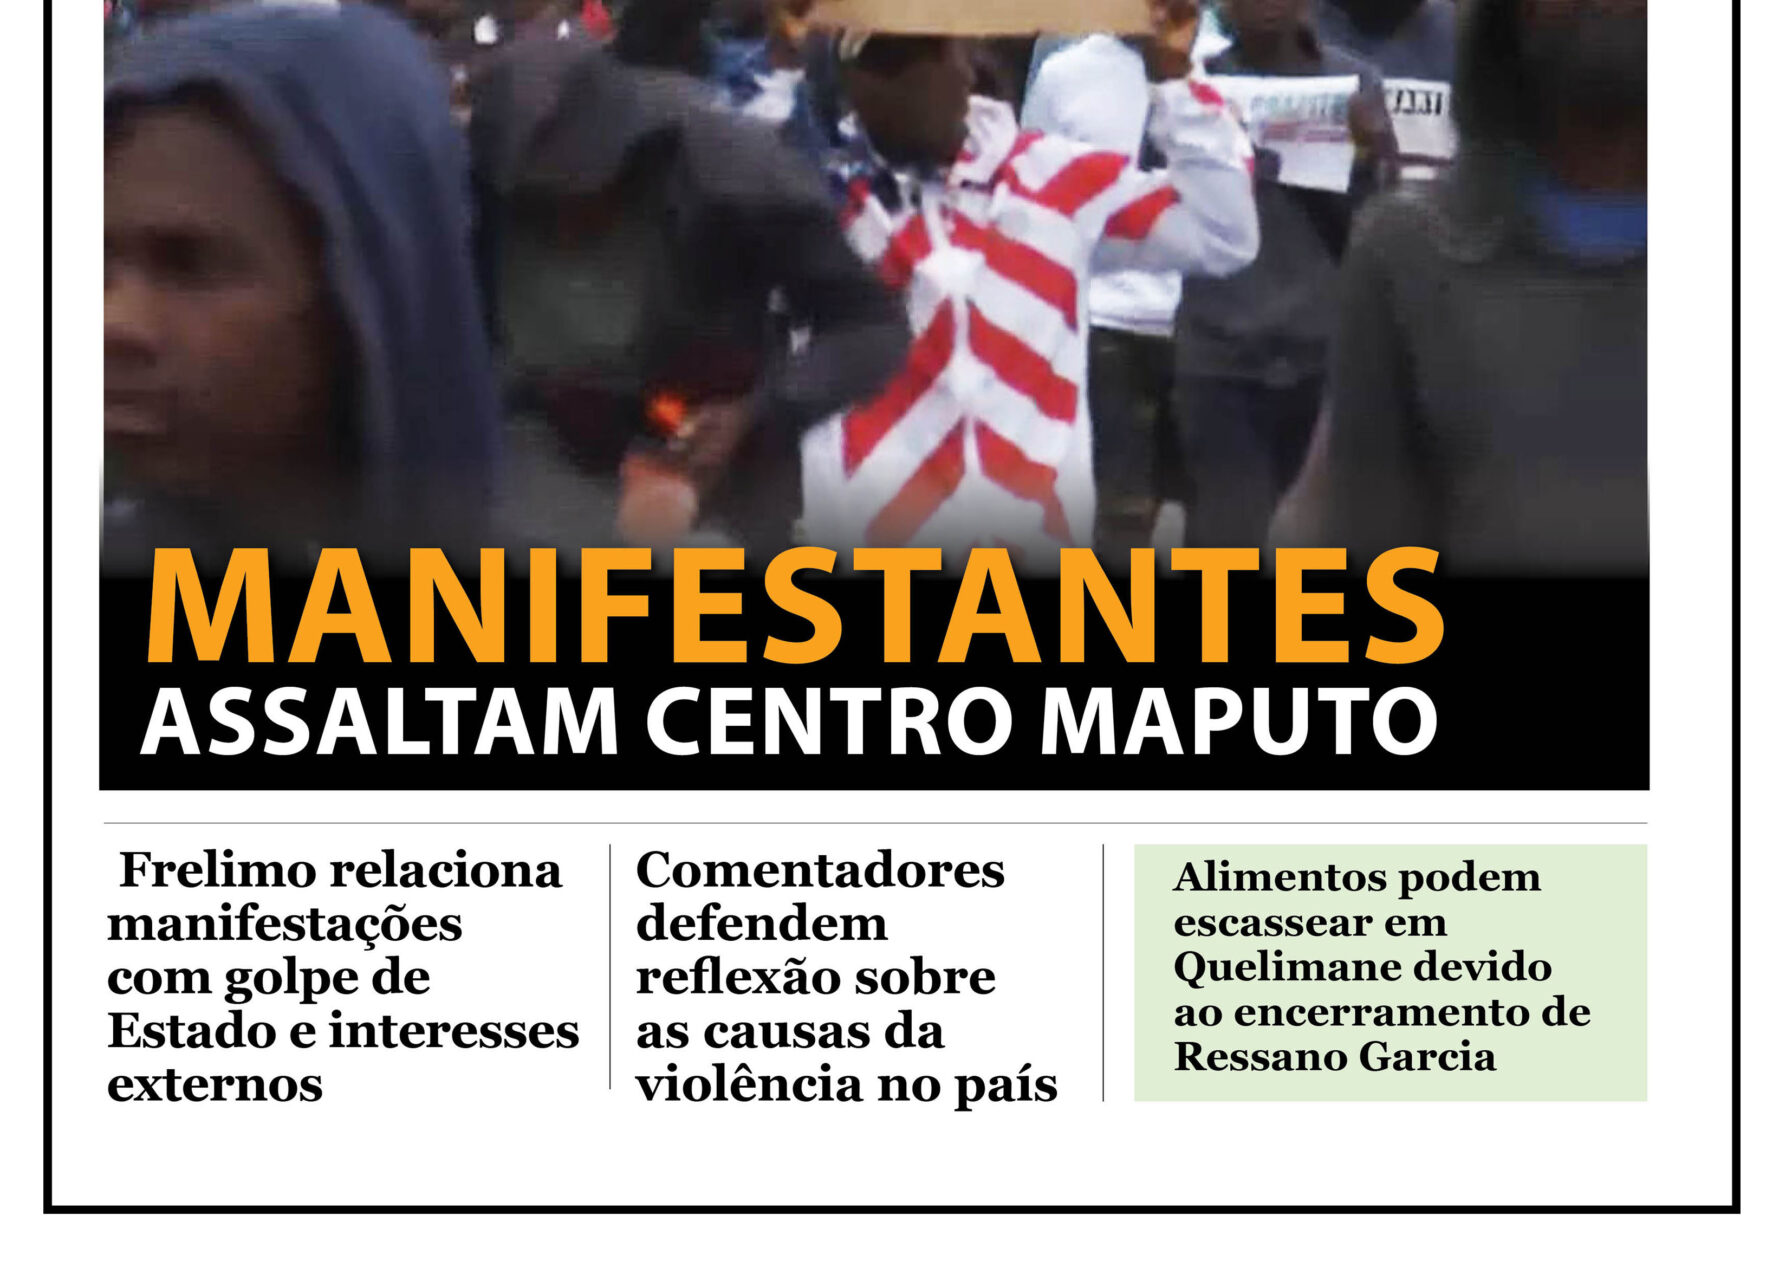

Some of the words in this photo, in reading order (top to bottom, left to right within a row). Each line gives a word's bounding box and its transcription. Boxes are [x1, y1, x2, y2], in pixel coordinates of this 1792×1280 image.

[148, 546, 1444, 664] MANIFESTANTES
[140, 687, 617, 755] ASSALTAM
[647, 687, 1012, 755] CENTRO
[1042, 687, 1437, 755] MAPUTO
[120, 849, 316, 888] Frelimo
[330, 849, 563, 888] relaciona
[637, 849, 1004, 888] Comentadores
[1172, 860, 1387, 891] Alimentos
[1398, 859, 1542, 900] podem
[107, 902, 462, 951] manifestações
[637, 902, 888, 941] defendem
[1175, 915, 1373, 936] escassear
[1385, 915, 1448, 936] em
[108, 968, 212, 995] com
[224, 955, 359, 1004] golpe
[372, 955, 430, 995] de
[636, 955, 841, 995] reflexão
[856, 955, 995, 995] sobre
[1175, 949, 1401, 989] Quelimane
[1414, 949, 1552, 981] devido
[108, 1009, 276, 1048] Estado
[290, 1022, 316, 1048] e
[329, 1009, 579, 1048] interesses
[637, 1022, 689, 1048] as
[704, 1022, 870, 1048] causas
[885, 1009, 945, 1048] da
[1175, 1005, 1222, 1026] ao
[1235, 1000, 1530, 1026] encerramento
[1542, 994, 1590, 1026] de
[1174, 1042, 1347, 1071] Ressano
[1360, 1039, 1497, 1071] Garcia
[108, 1069, 322, 1102] externos
[635, 1063, 864, 1102] violência
[877, 1076, 941, 1102] no
[954, 1063, 1057, 1112] país
